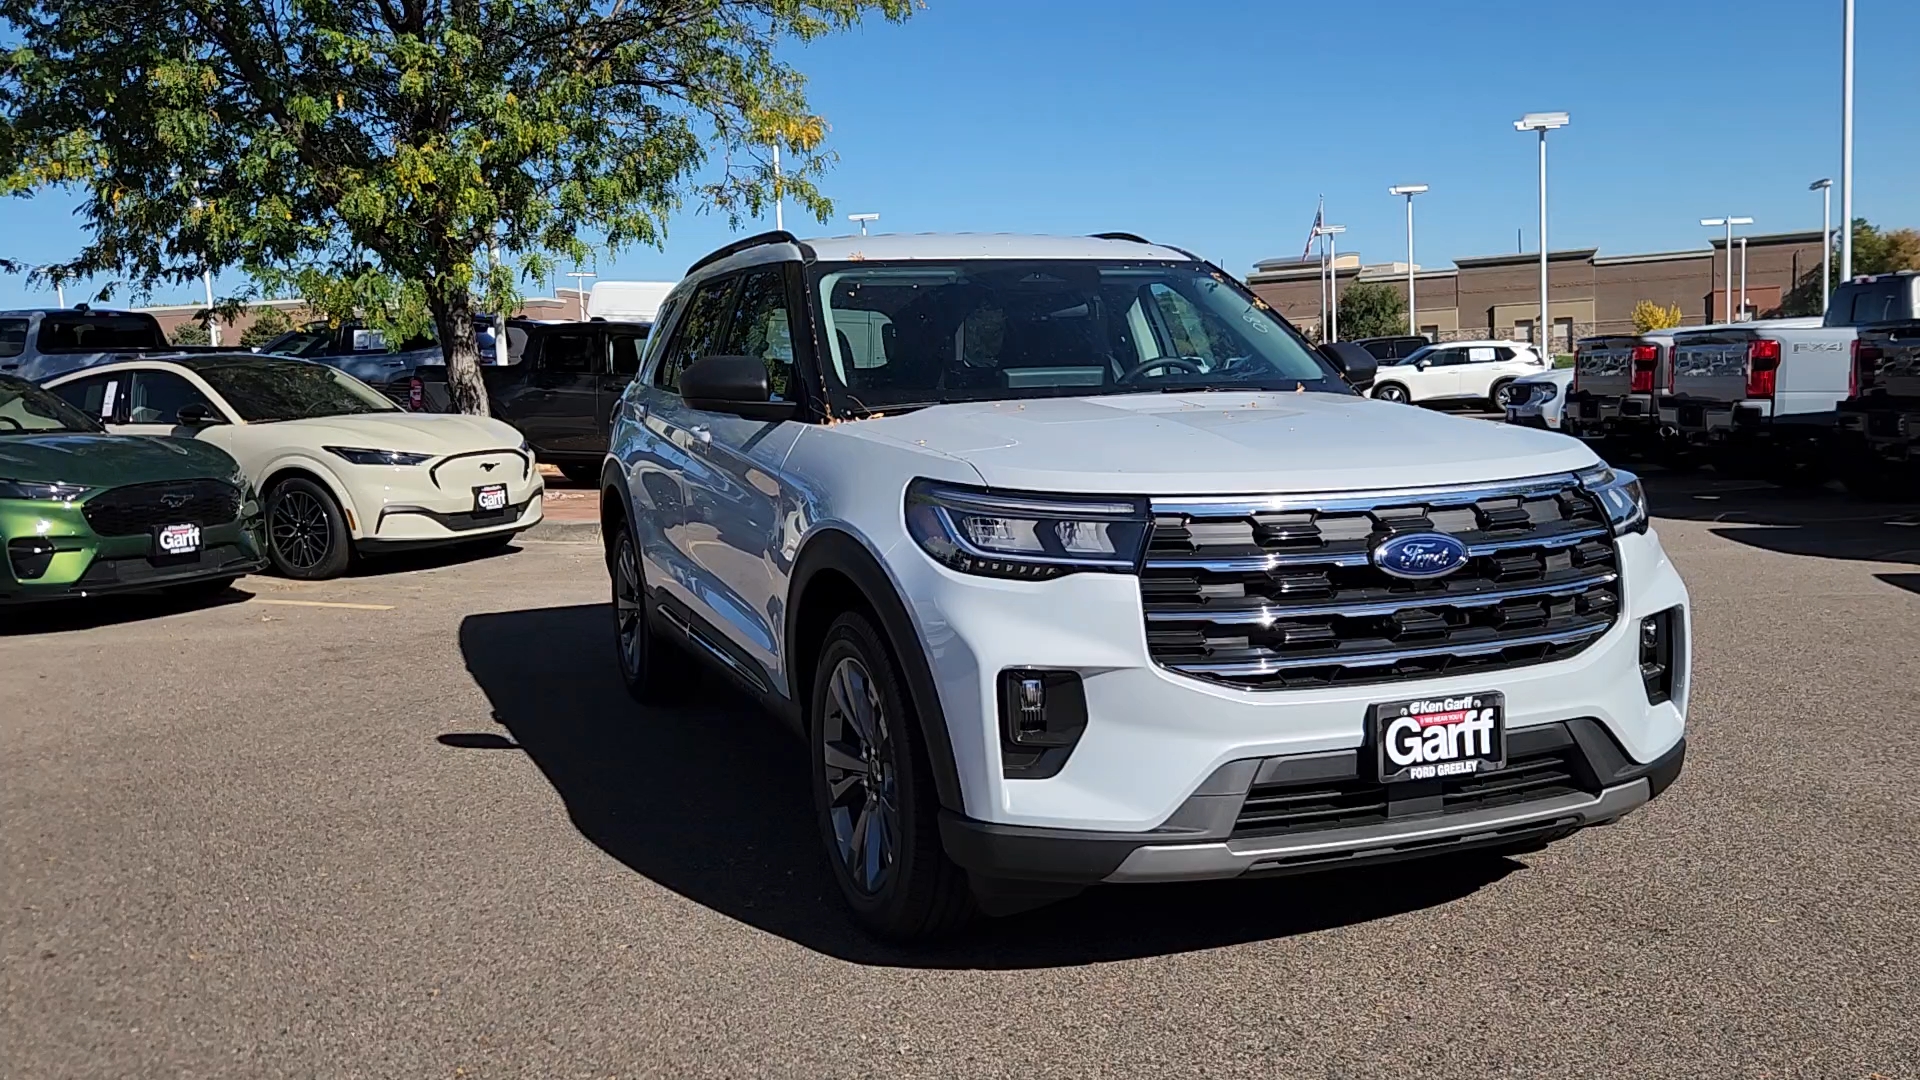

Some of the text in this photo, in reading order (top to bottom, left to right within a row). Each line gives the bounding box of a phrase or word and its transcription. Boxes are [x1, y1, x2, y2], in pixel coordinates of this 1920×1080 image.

[1793, 341, 1844, 355] FX4
[160, 527, 200, 550] Garff
[1401, 543, 1449, 568] Ford
[1420, 696, 1473, 714] Ken Garff
[1385, 708, 1494, 766] Garff
[1410, 760, 1479, 780] FORD GREELEY
